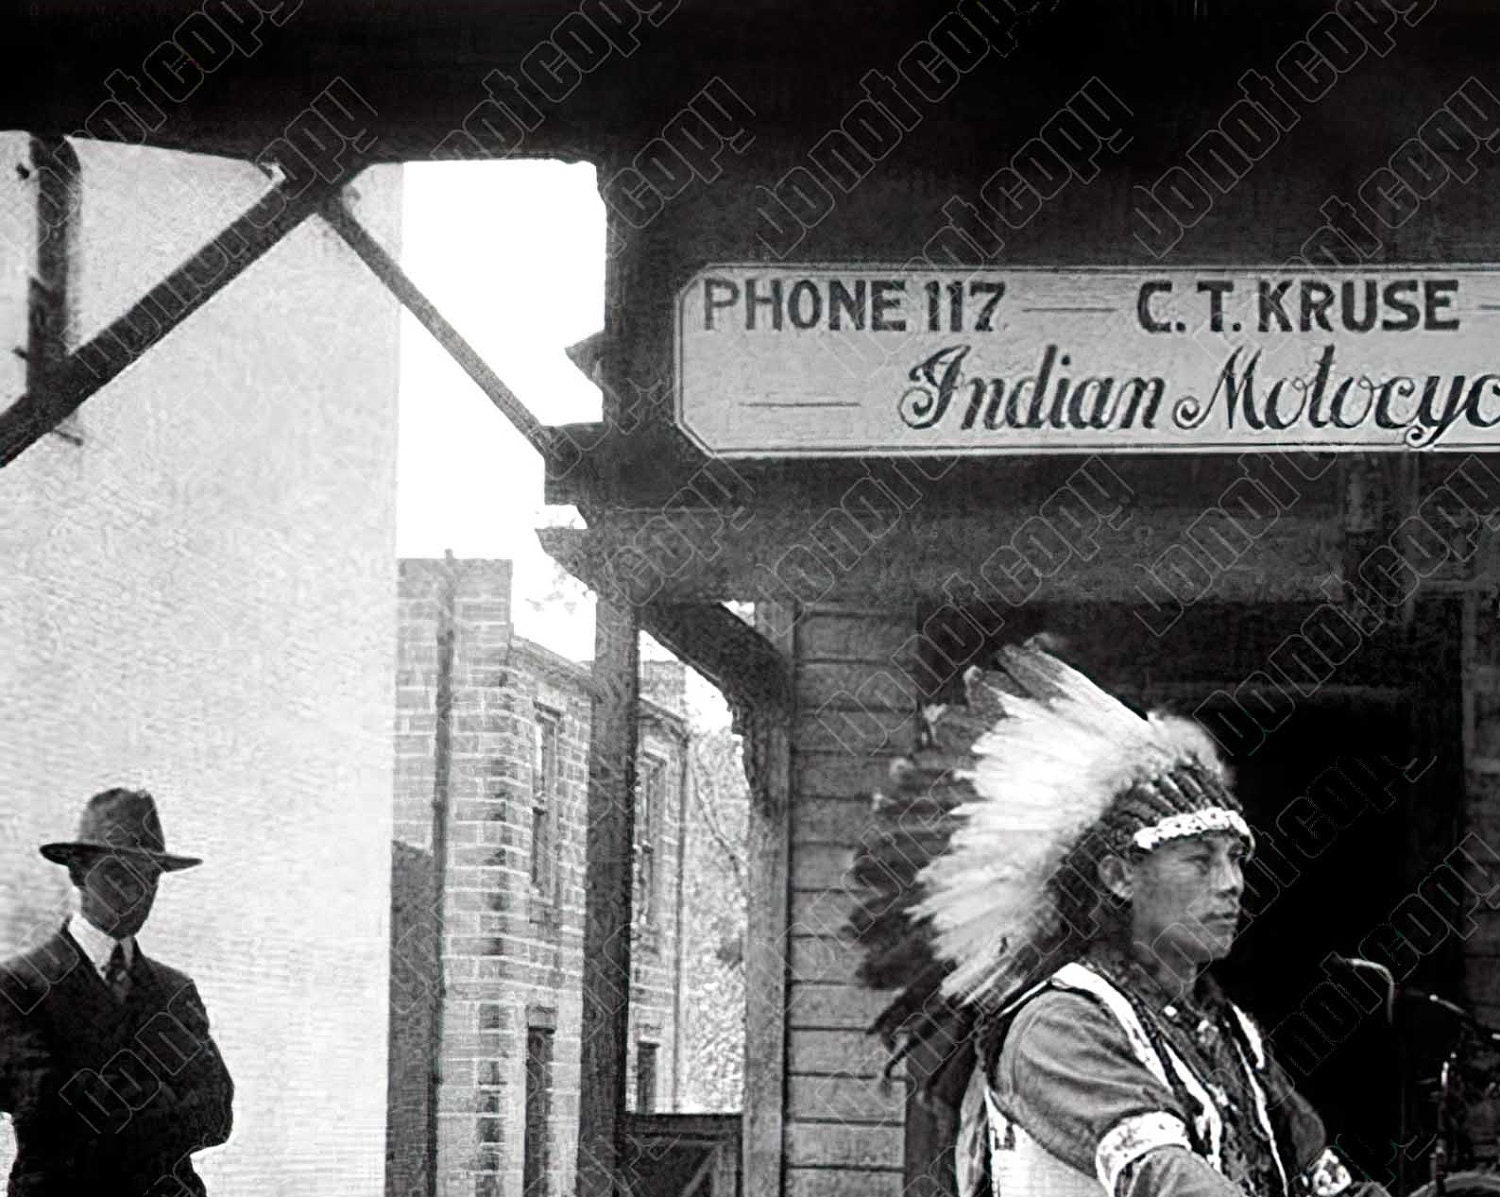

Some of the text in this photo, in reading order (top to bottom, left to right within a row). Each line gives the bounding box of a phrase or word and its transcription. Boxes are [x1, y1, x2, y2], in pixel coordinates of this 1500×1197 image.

[704, 278, 906, 331] PHONE
[923, 280, 1006, 332] 117
[896, 344, 1166, 430] Indian
